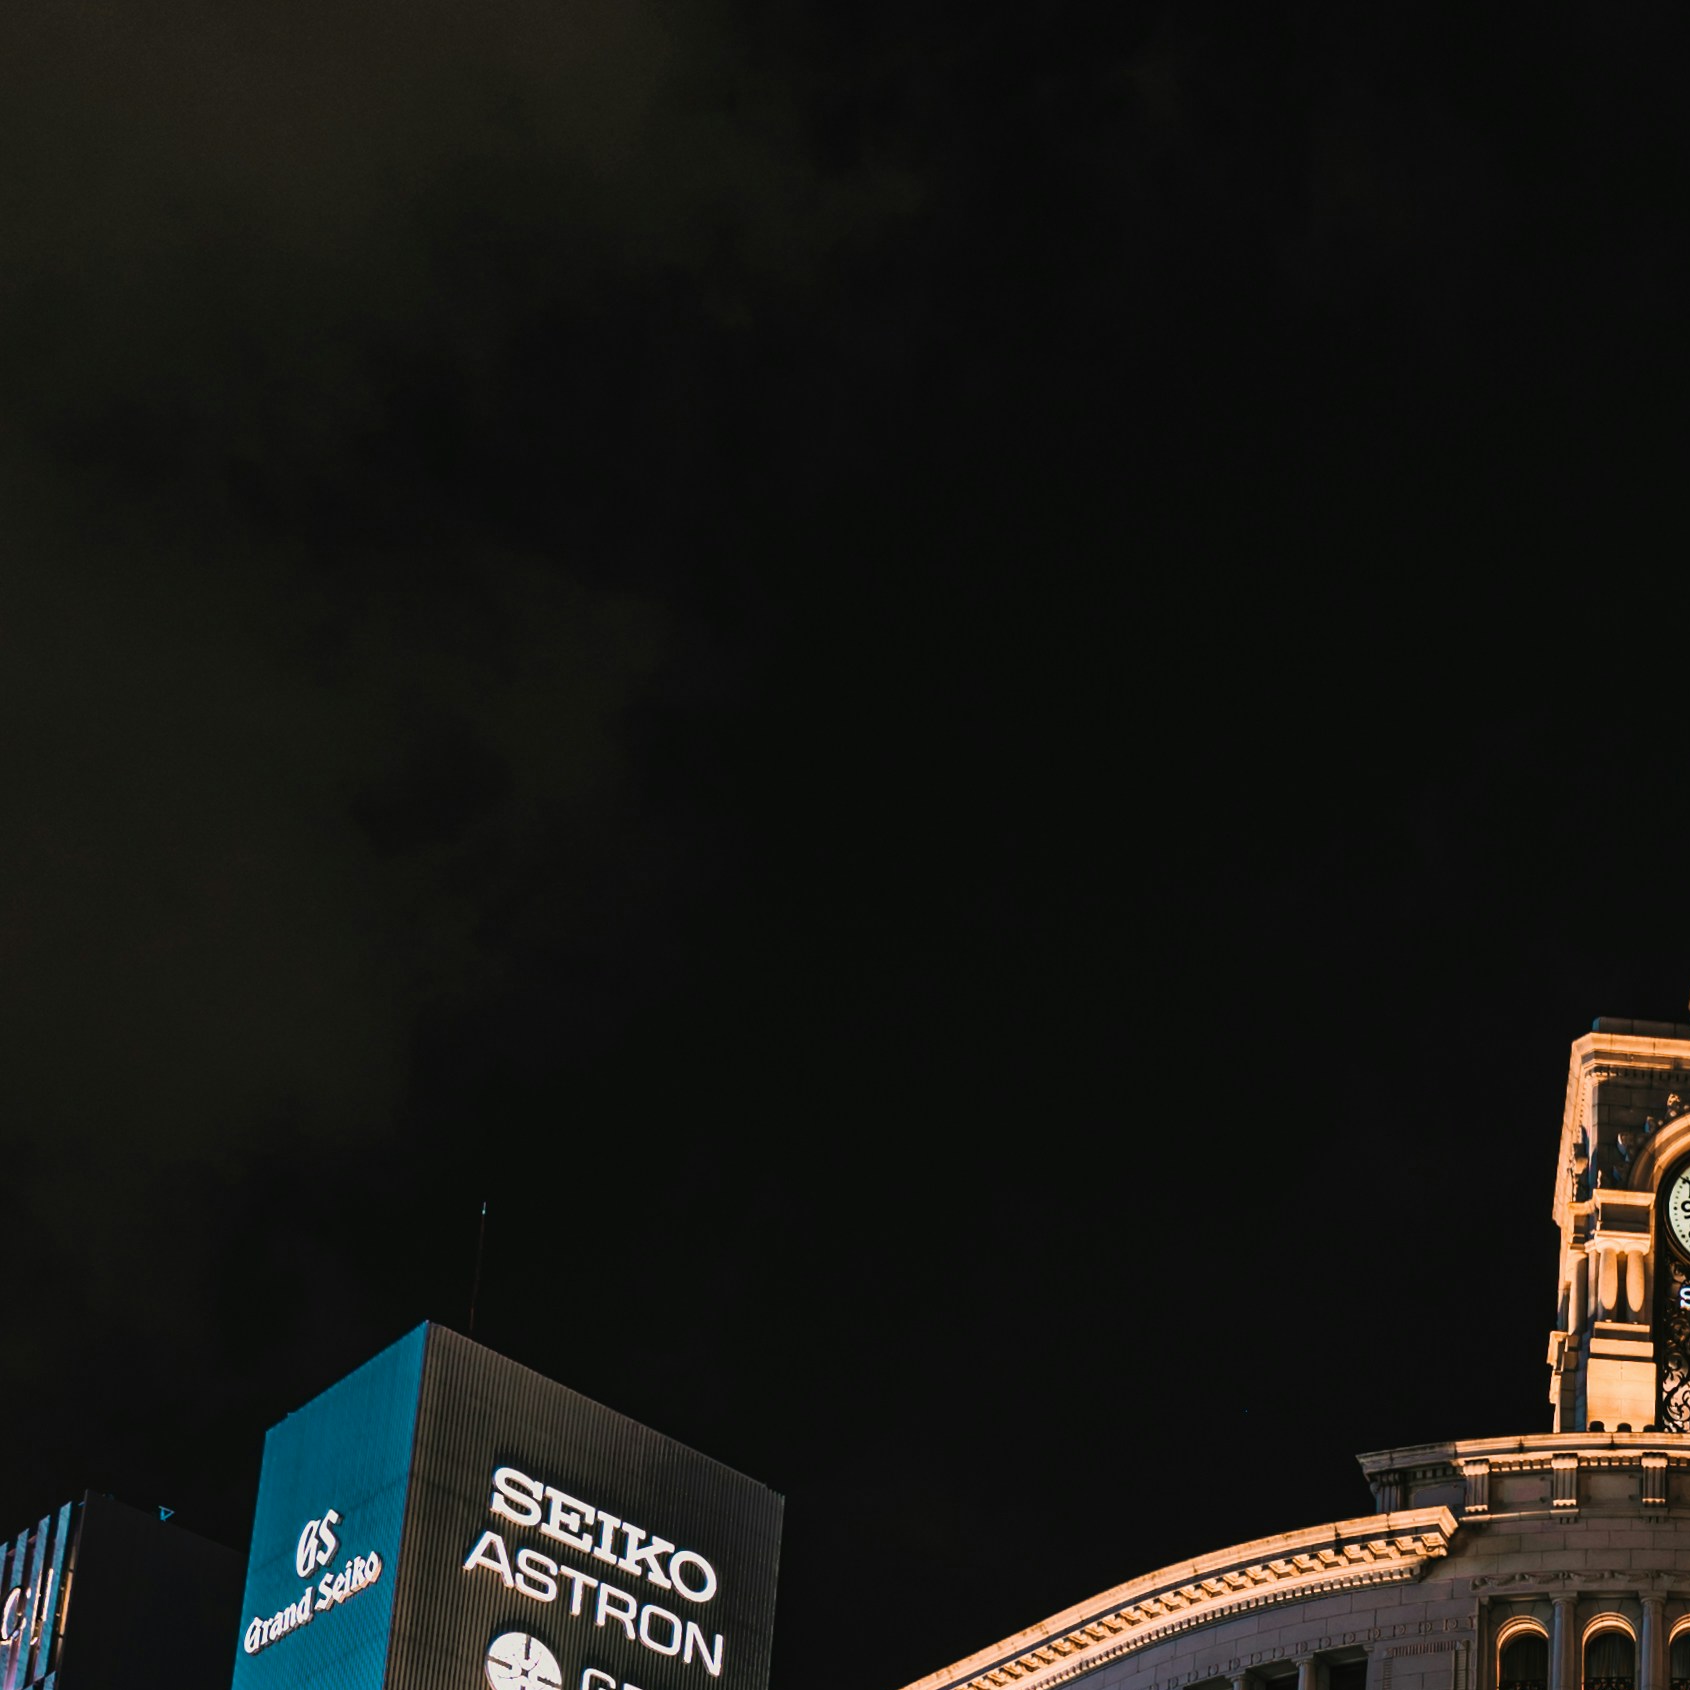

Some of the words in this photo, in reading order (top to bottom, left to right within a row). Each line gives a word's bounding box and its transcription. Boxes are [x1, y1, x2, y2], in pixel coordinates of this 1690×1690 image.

[296, 1508, 340, 1579] GS
[490, 1466, 718, 1603] SEIKO
[244, 1586, 315, 1655] Grand
[314, 1550, 381, 1611] Seiko
[463, 1530, 724, 1678] ASTRON
